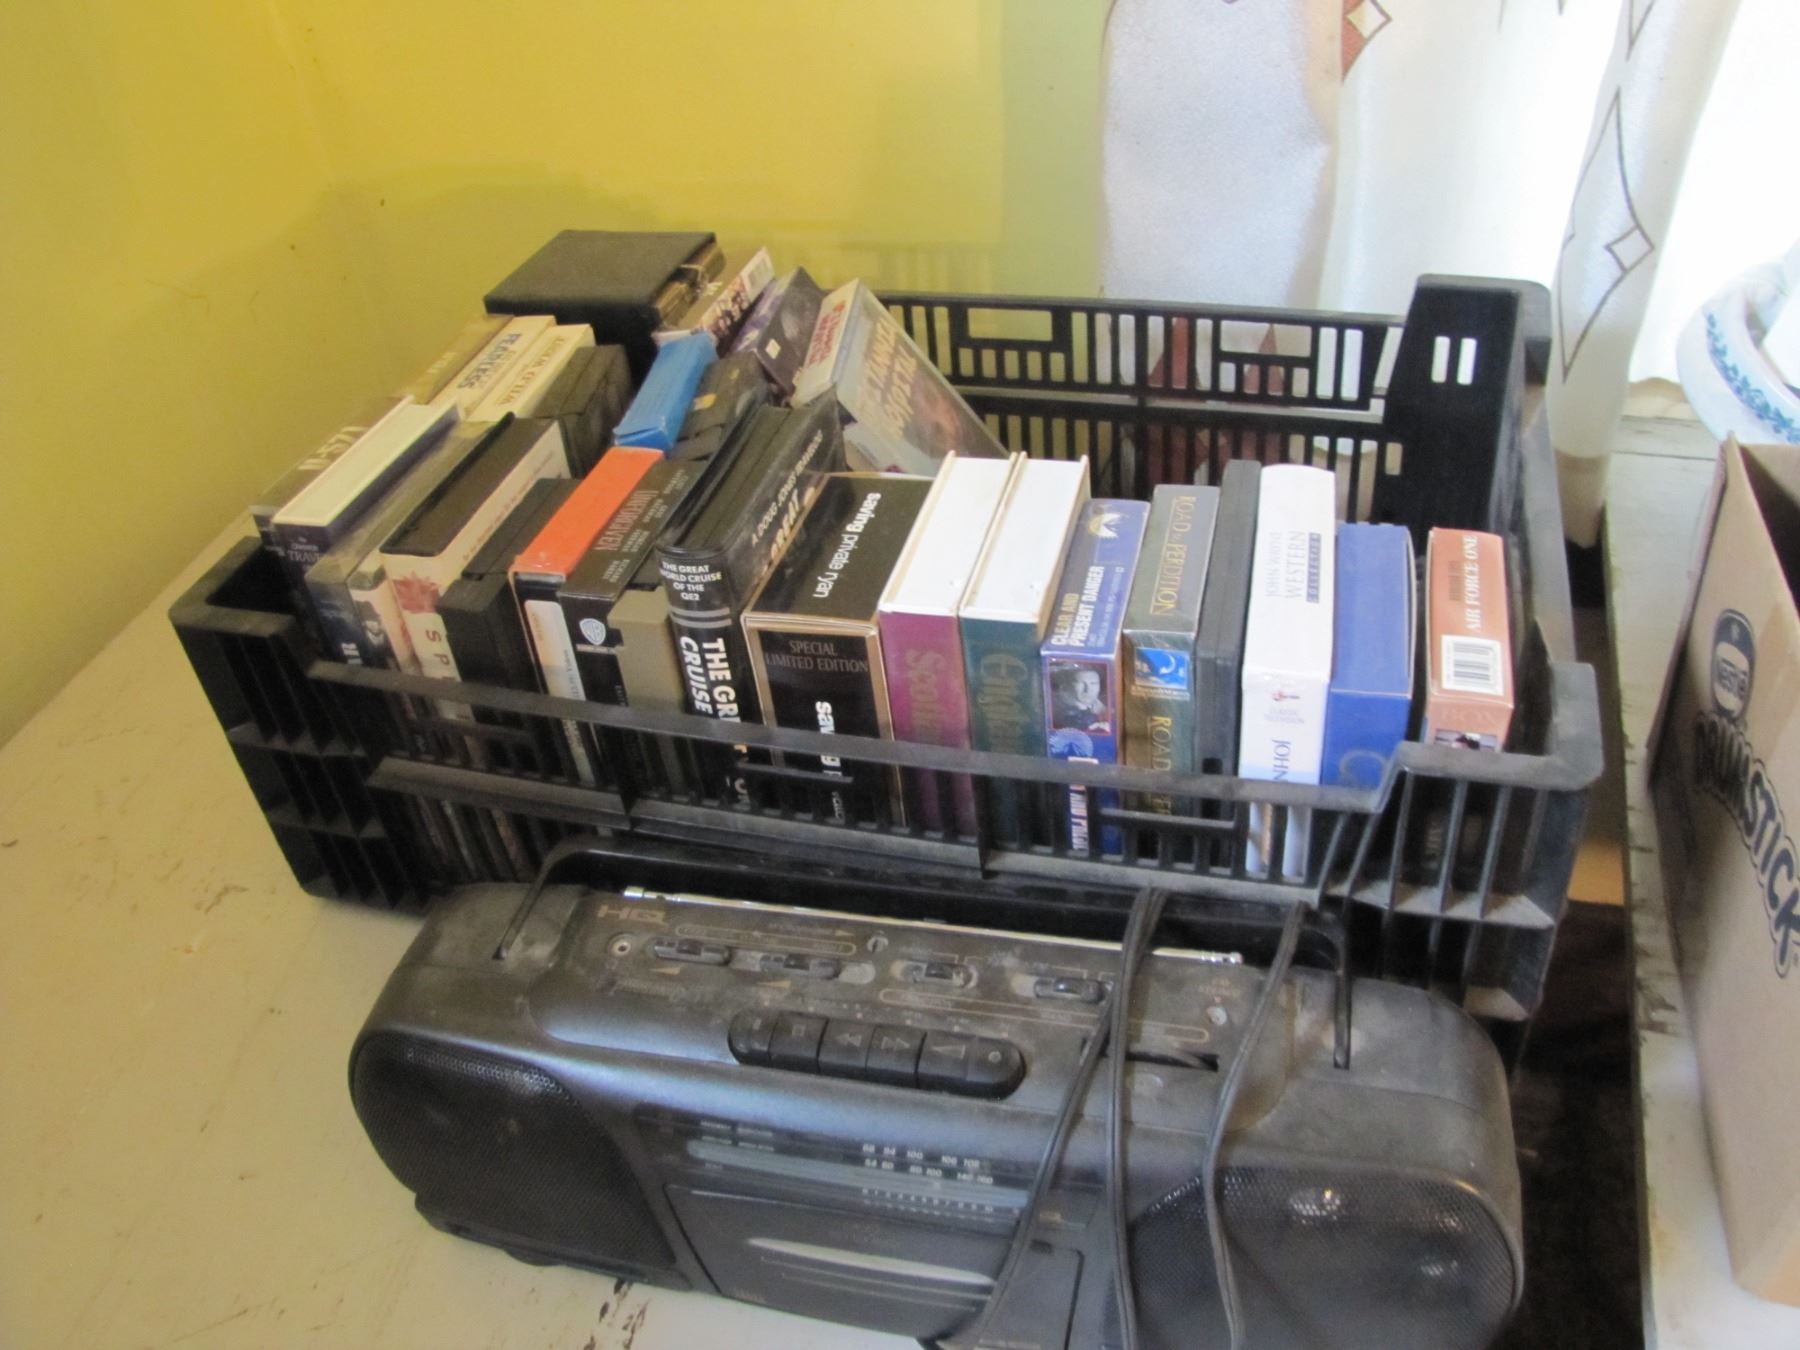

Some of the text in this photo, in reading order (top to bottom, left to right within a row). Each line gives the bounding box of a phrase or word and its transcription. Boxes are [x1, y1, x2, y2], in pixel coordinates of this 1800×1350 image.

[661, 561, 710, 574] THE GREAT
[812, 492, 882, 599] saving private ryan
[1284, 530, 1306, 599] WESTERN
[673, 582, 705, 592] OF THE
[680, 592, 701, 601] QE2
[687, 571, 723, 583] CRUISE
[1082, 565, 1105, 602] DANGER
[1463, 535, 1482, 632] AIR FORCE ONE
[1051, 592, 1080, 646] CLEAR AND
[1070, 602, 1096, 648] PRESENT
[702, 637, 733, 682] THE
[765, 652, 869, 673] LIMITED EDITION
[789, 640, 839, 657] SPECIAL
[679, 635, 714, 715] CRUISE
[1152, 715, 1172, 773] ROAD
[1271, 739, 1292, 782] JOHN
